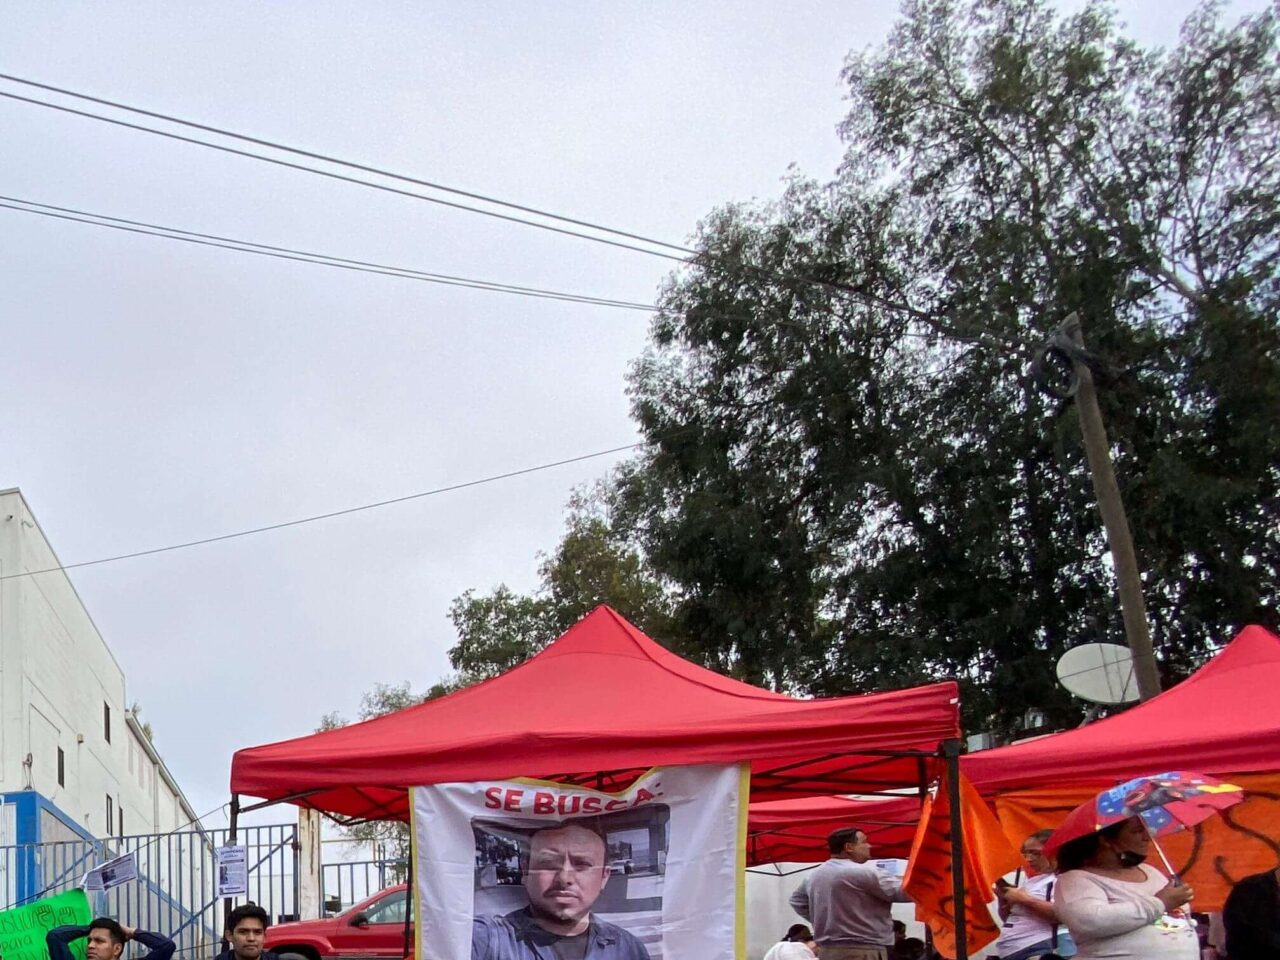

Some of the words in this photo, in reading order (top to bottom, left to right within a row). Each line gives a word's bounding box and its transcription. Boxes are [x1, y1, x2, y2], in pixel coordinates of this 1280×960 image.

[485, 786, 524, 813] SE
[533, 783, 664, 815] BUSCA:
[1, 935, 33, 953] para
